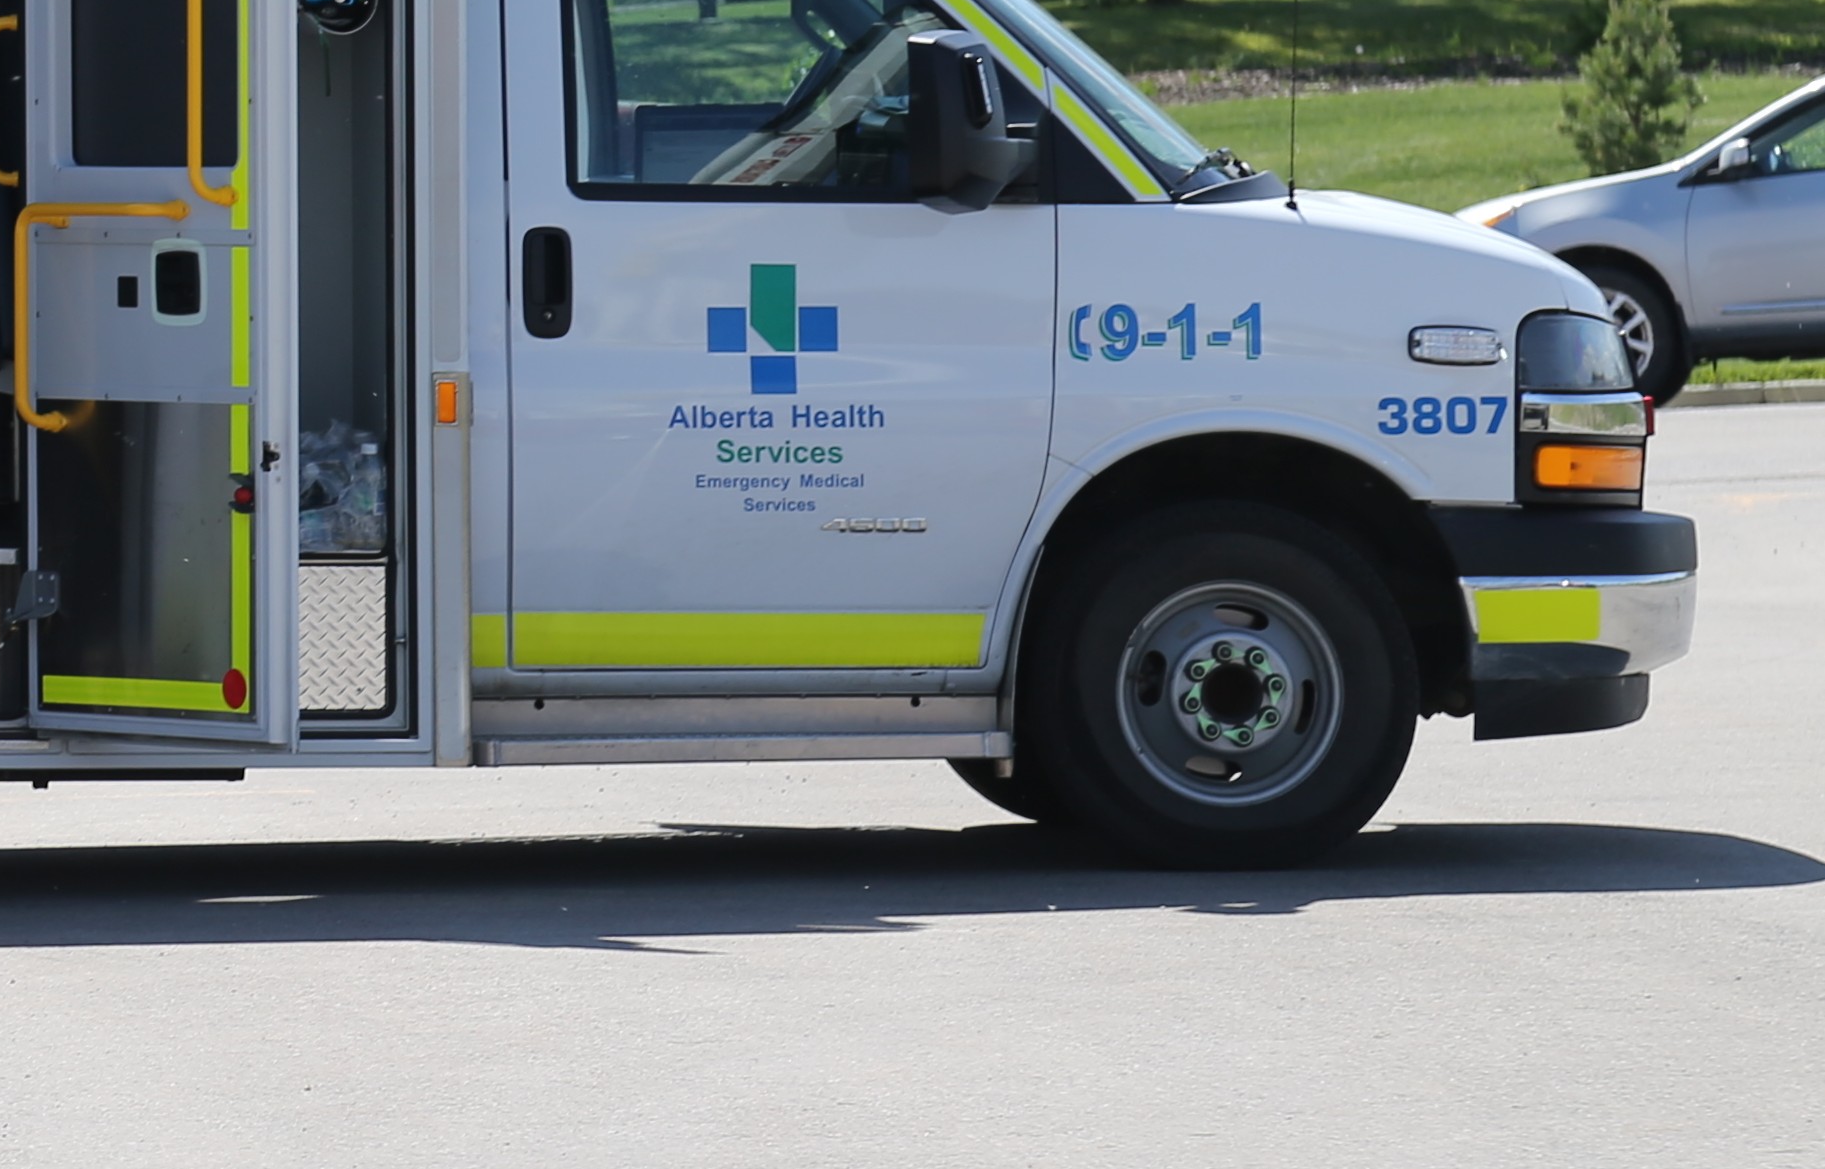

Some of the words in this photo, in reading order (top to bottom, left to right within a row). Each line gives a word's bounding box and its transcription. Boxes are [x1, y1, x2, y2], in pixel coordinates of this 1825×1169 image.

[1098, 301, 1262, 362] 9-1-1
[667, 404, 775, 429] Alberta
[791, 404, 885, 429] Health
[1377, 395, 1509, 436] 3807
[715, 438, 844, 464] Services
[694, 473, 791, 492] Emergency
[798, 472, 865, 488] Medical
[742, 496, 817, 512] Services
[820, 516, 928, 534] 4500
